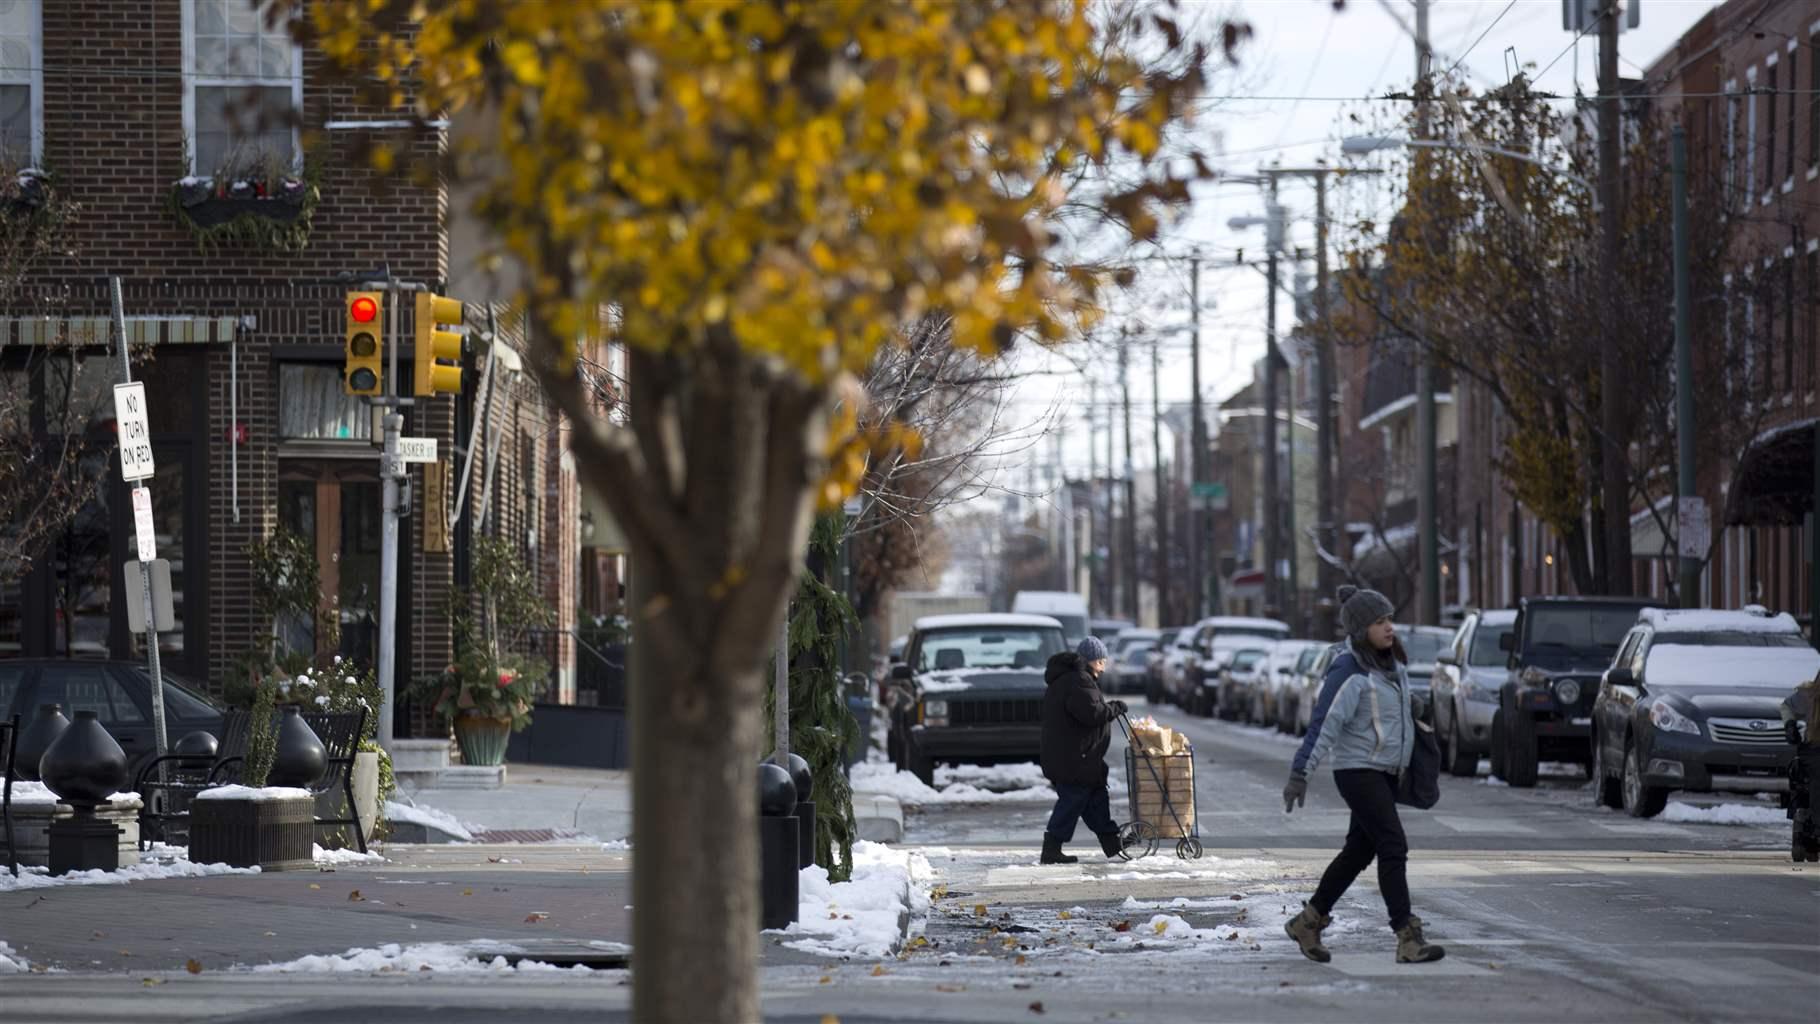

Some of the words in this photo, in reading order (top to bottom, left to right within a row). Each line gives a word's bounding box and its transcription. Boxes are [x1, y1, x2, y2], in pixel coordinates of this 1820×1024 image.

[126, 395, 138, 413] NO
[124, 420, 145, 439] TURN
[123, 447, 135, 465] ON
[136, 444, 150, 464] RED
[400, 442, 424, 457] TASKER
